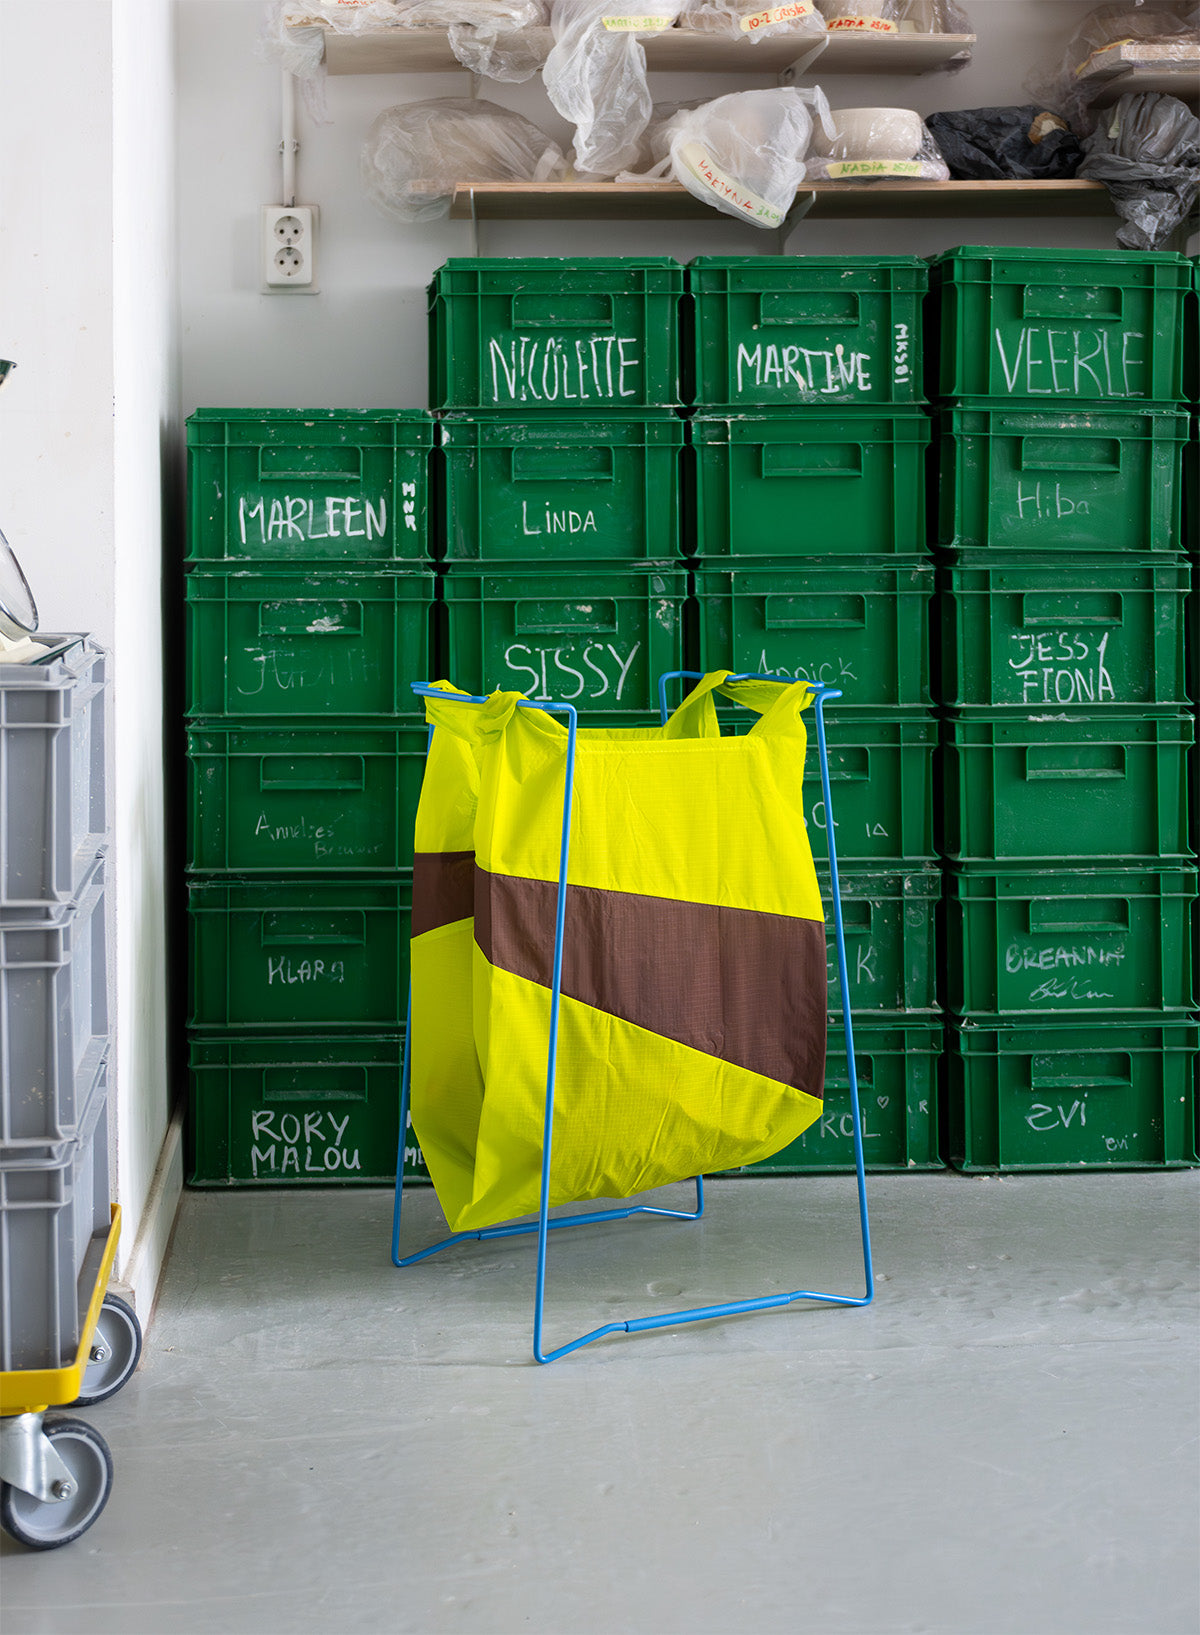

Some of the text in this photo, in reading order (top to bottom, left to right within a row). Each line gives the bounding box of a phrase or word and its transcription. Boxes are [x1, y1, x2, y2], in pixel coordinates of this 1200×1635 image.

[489, 335, 640, 402] NICOLETTE
[737, 343, 872, 394] MARTINE
[994, 327, 1145, 398] VEERLE
[239, 495, 387, 545] MARLEEN
[1016, 481, 1090, 519] Hiba
[504, 643, 641, 702] SISSY
[1008, 632, 1109, 669] JESSY
[1016, 667, 1116, 703] FIONA
[252, 1110, 349, 1147] RORY
[252, 1144, 361, 1177] MALOU
